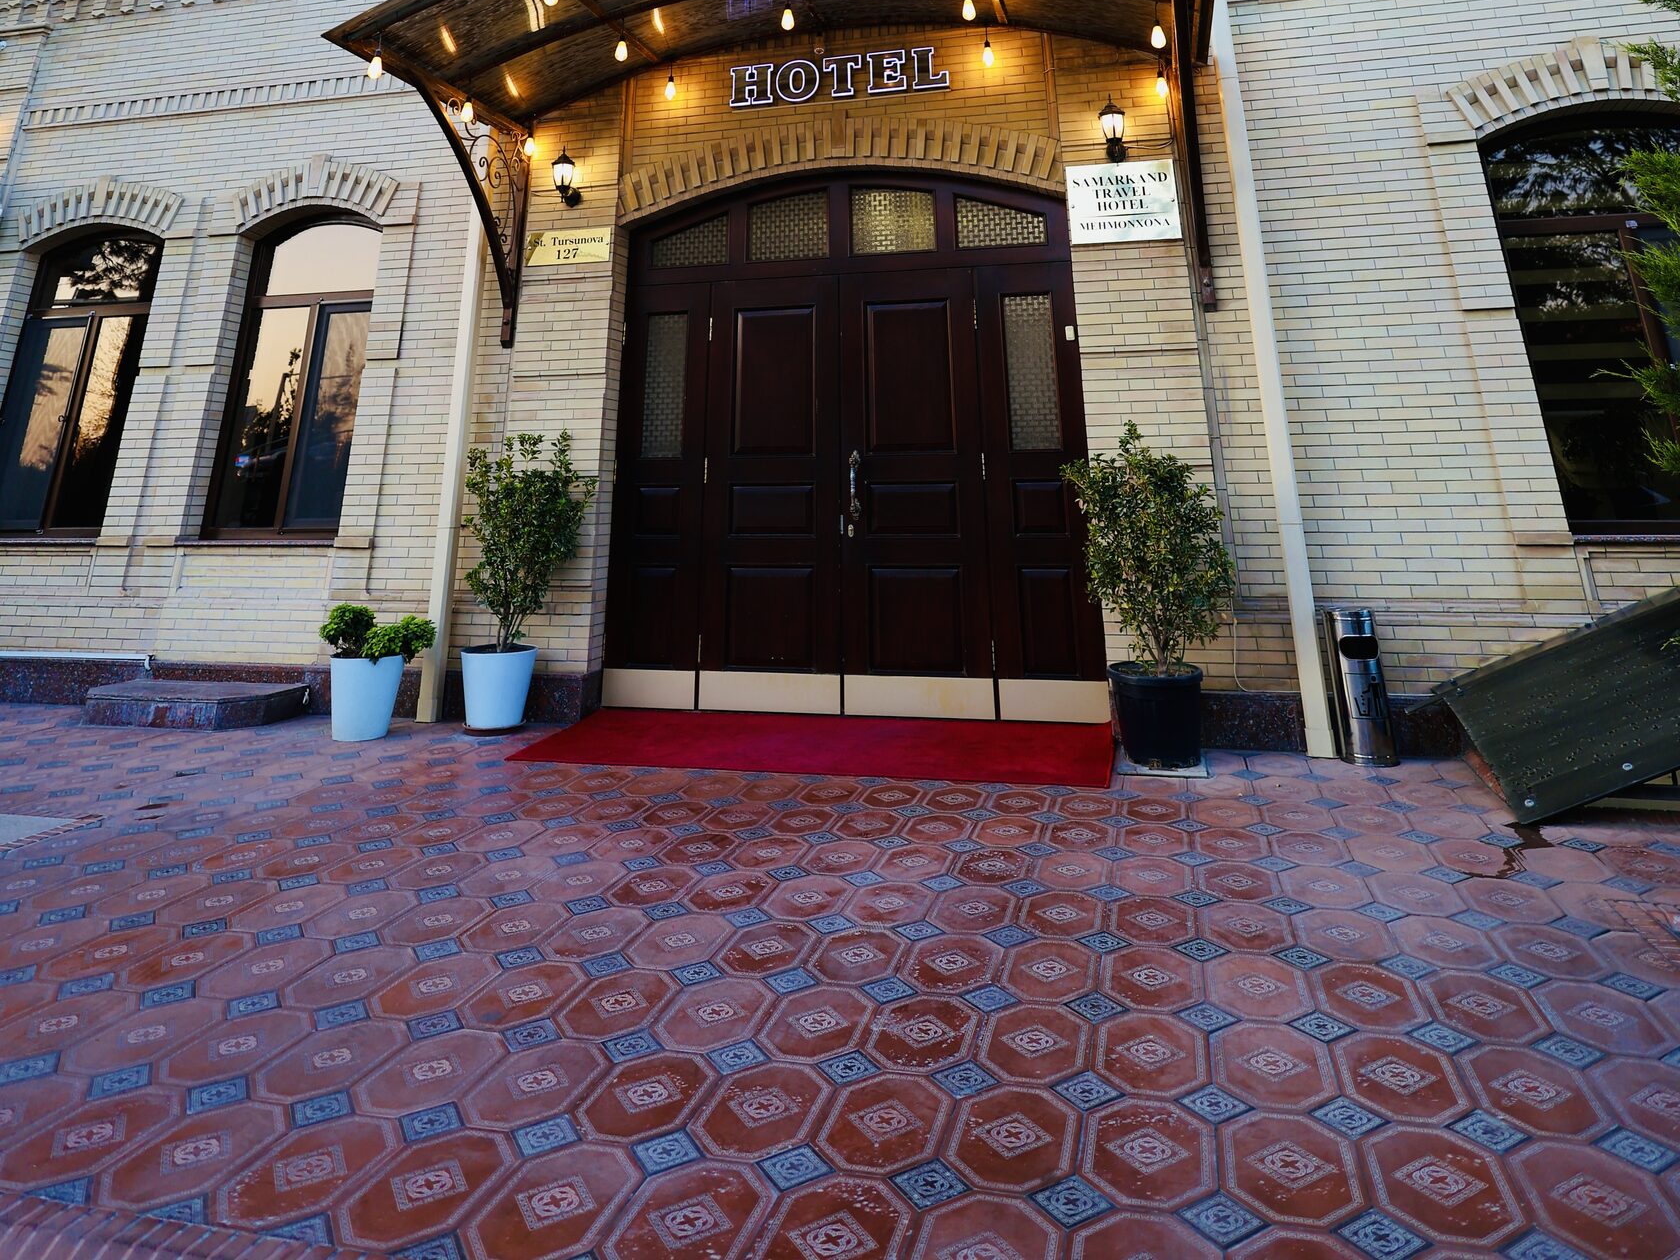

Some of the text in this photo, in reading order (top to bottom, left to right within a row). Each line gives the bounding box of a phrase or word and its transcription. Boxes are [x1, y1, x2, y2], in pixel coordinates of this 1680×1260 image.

[729, 47, 950, 107] HOTEL
[1072, 172, 1168, 188] SAMARKAND
[1094, 186, 1151, 199] TRAVEL
[1097, 199, 1149, 211] HOTEL
[1080, 218, 1170, 230] MEHMONXONA
[533, 236, 604, 247] St. Tursunova
[556, 248, 579, 260] 127
